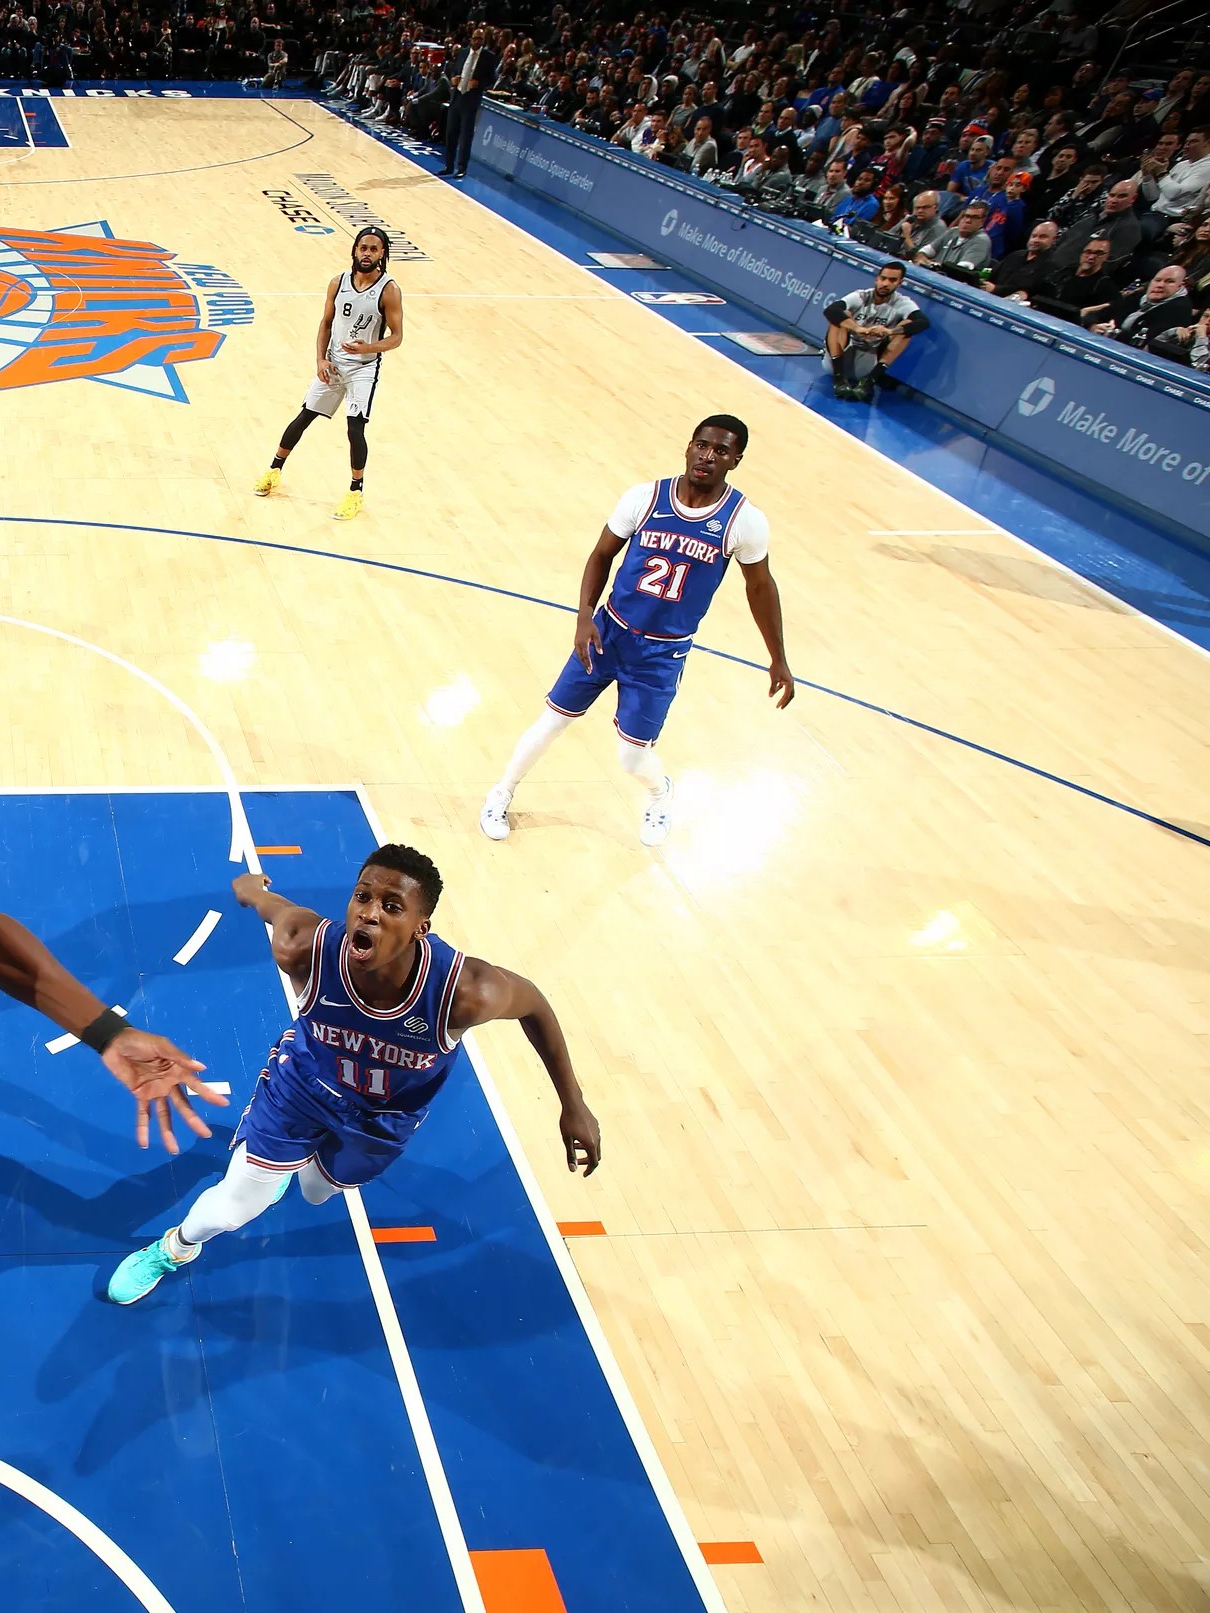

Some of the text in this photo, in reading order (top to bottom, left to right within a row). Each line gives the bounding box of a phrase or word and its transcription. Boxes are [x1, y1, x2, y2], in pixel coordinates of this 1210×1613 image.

[548, 160, 570, 178] Square
[569, 170, 594, 192] Garden
[261, 189, 321, 223] CHASE
[678, 222, 702, 247] Make
[701, 233, 727, 258] More
[726, 247, 743, 264] of
[739, 251, 783, 285] Madison
[781, 271, 823, 306] Square
[172, 262, 255, 327] NEW YORK
[342, 302, 353, 317] 8
[1109, 364, 1128, 375] CHASE
[1136, 375, 1155, 386] CHASE
[1164, 386, 1185, 397] CHASE
[1056, 401, 1210, 485] Make More of
[639, 530, 720, 564] NEW YORK
[637, 555, 690, 602] 21
[310, 1021, 438, 1070] NEW YORK
[338, 1056, 390, 1099] 11
